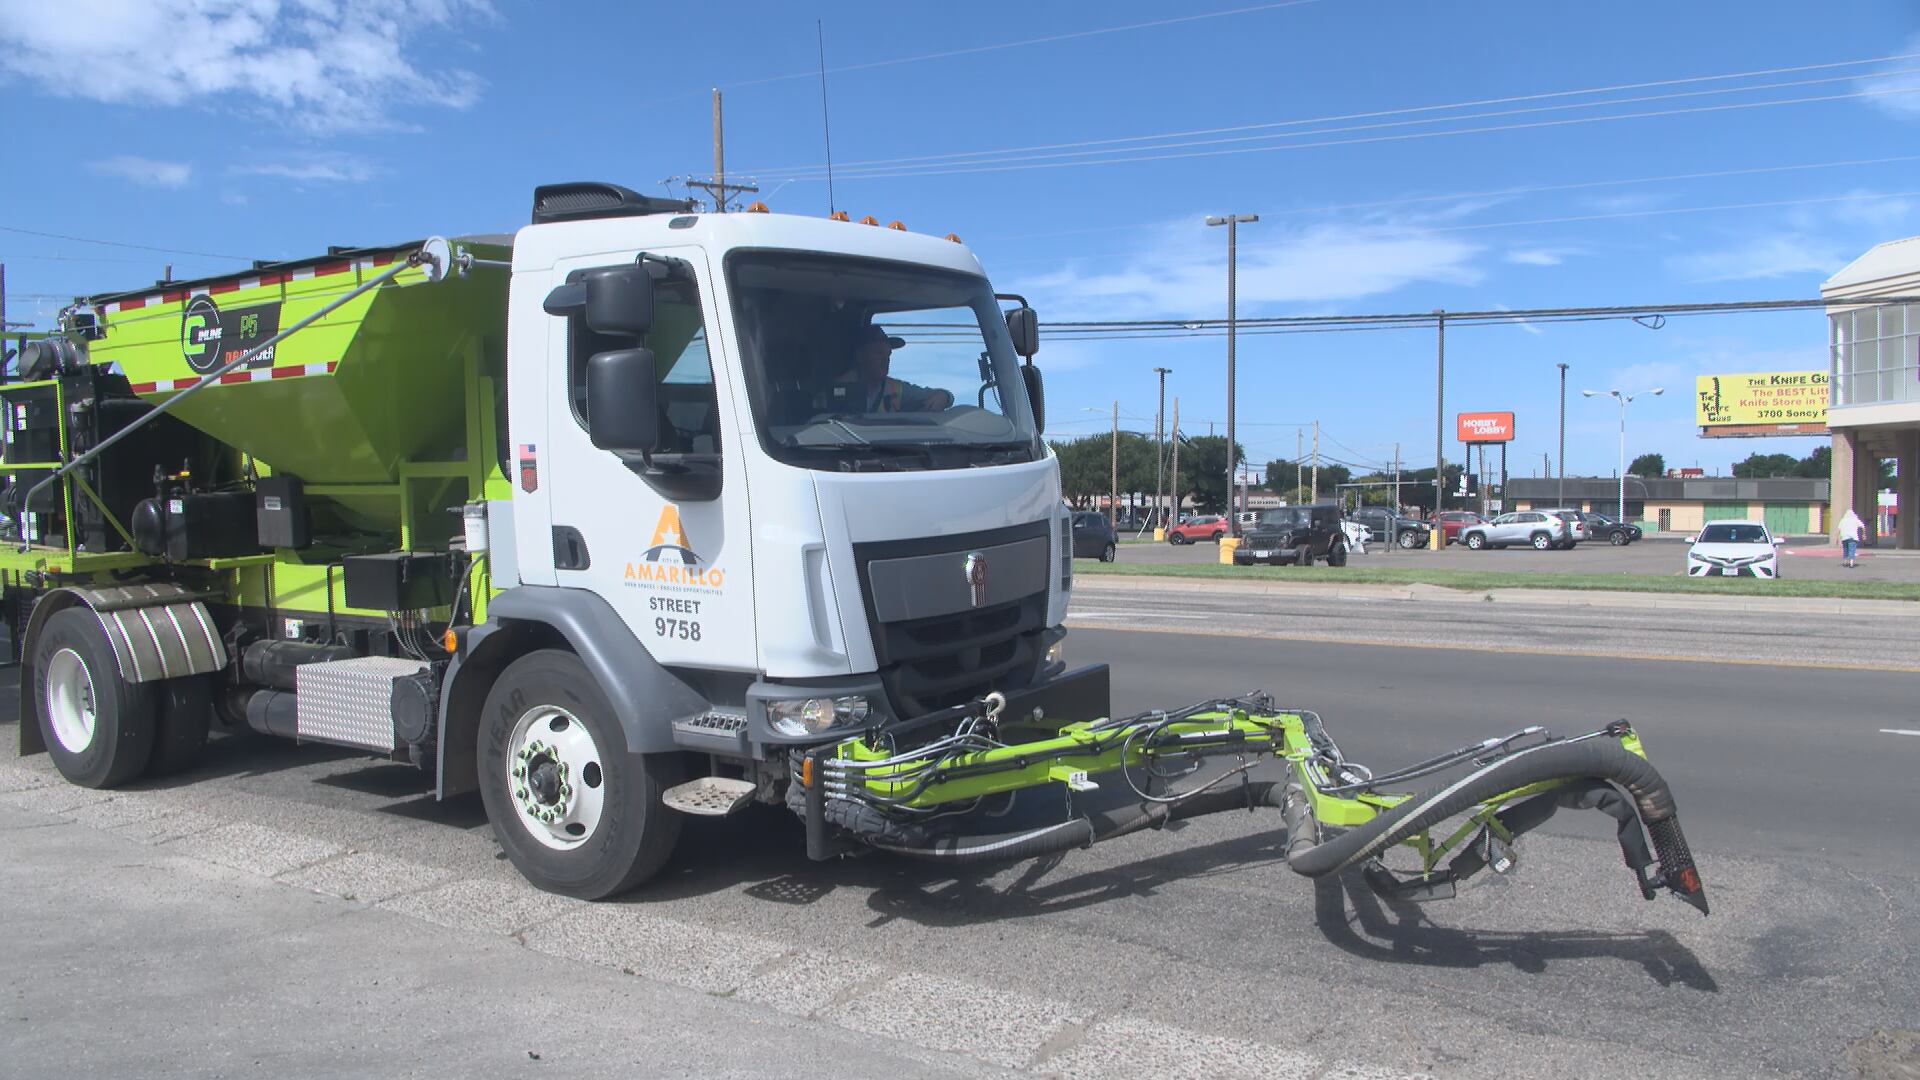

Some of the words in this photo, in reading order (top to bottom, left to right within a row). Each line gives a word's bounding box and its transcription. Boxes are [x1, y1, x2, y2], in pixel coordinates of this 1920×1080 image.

[1770, 375, 1807, 385] KNIFE
[1752, 389, 1773, 397] The
[1775, 387, 1806, 396] BEST
[1739, 399, 1769, 407] Knife
[1772, 398, 1801, 406] Store
[1757, 410, 1783, 418] 3700
[1786, 409, 1818, 418] Soncy
[1463, 419, 1497, 428] HOBBY
[1474, 426, 1506, 435] LOBBY
[624, 562, 723, 588] AMARILLO
[649, 597, 701, 614] STREET
[655, 617, 702, 641] 9758
